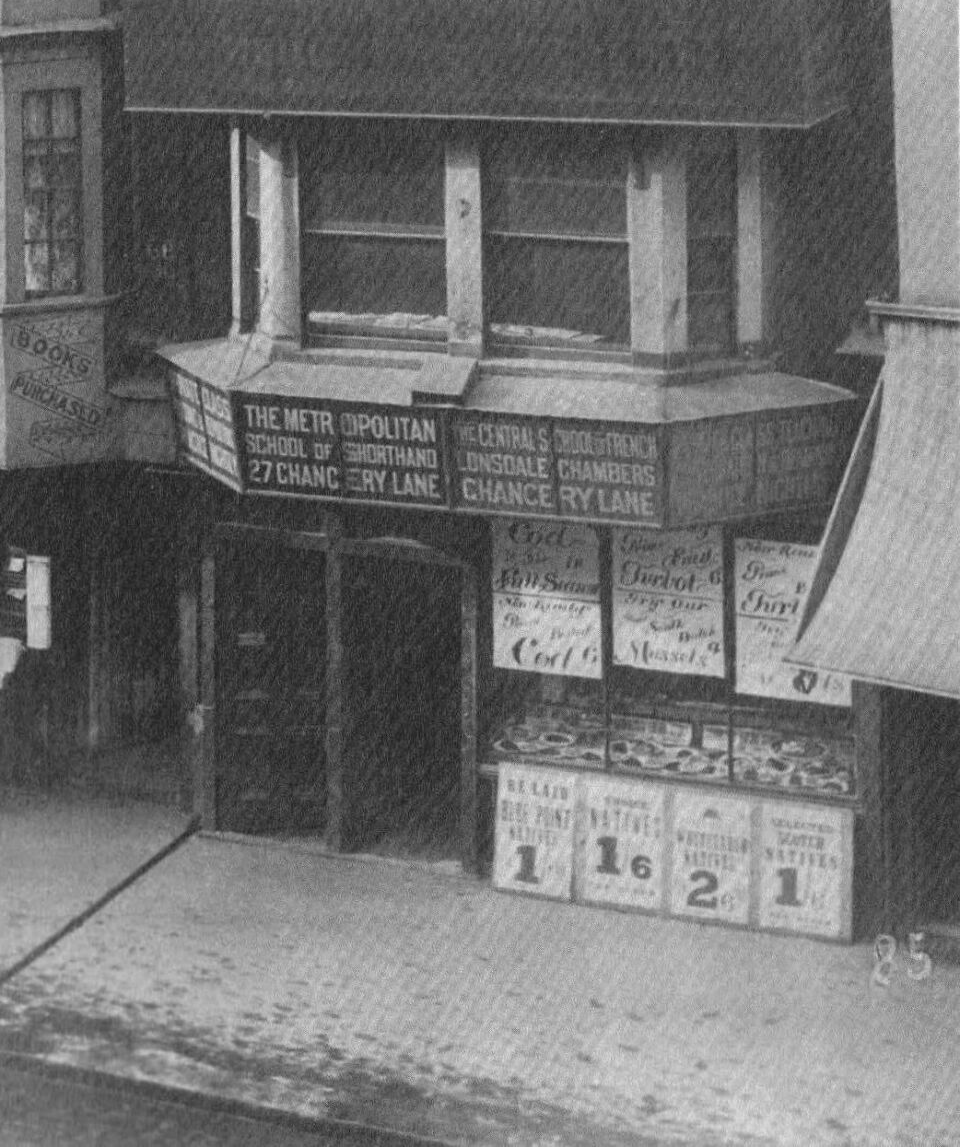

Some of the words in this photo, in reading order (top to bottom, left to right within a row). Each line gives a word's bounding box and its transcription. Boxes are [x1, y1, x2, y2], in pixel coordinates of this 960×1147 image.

[244, 404, 281, 430] THE
[245, 433, 308, 459] SCHOOL
[315, 442, 333, 461] OF
[478, 423, 537, 452] CENTRAL
[249, 459, 272, 483] 27
[392, 471, 441, 499] LANE
[459, 451, 549, 479] LONSDALE
[557, 458, 656, 487] CHAMBERS
[598, 489, 655, 517] LANE
